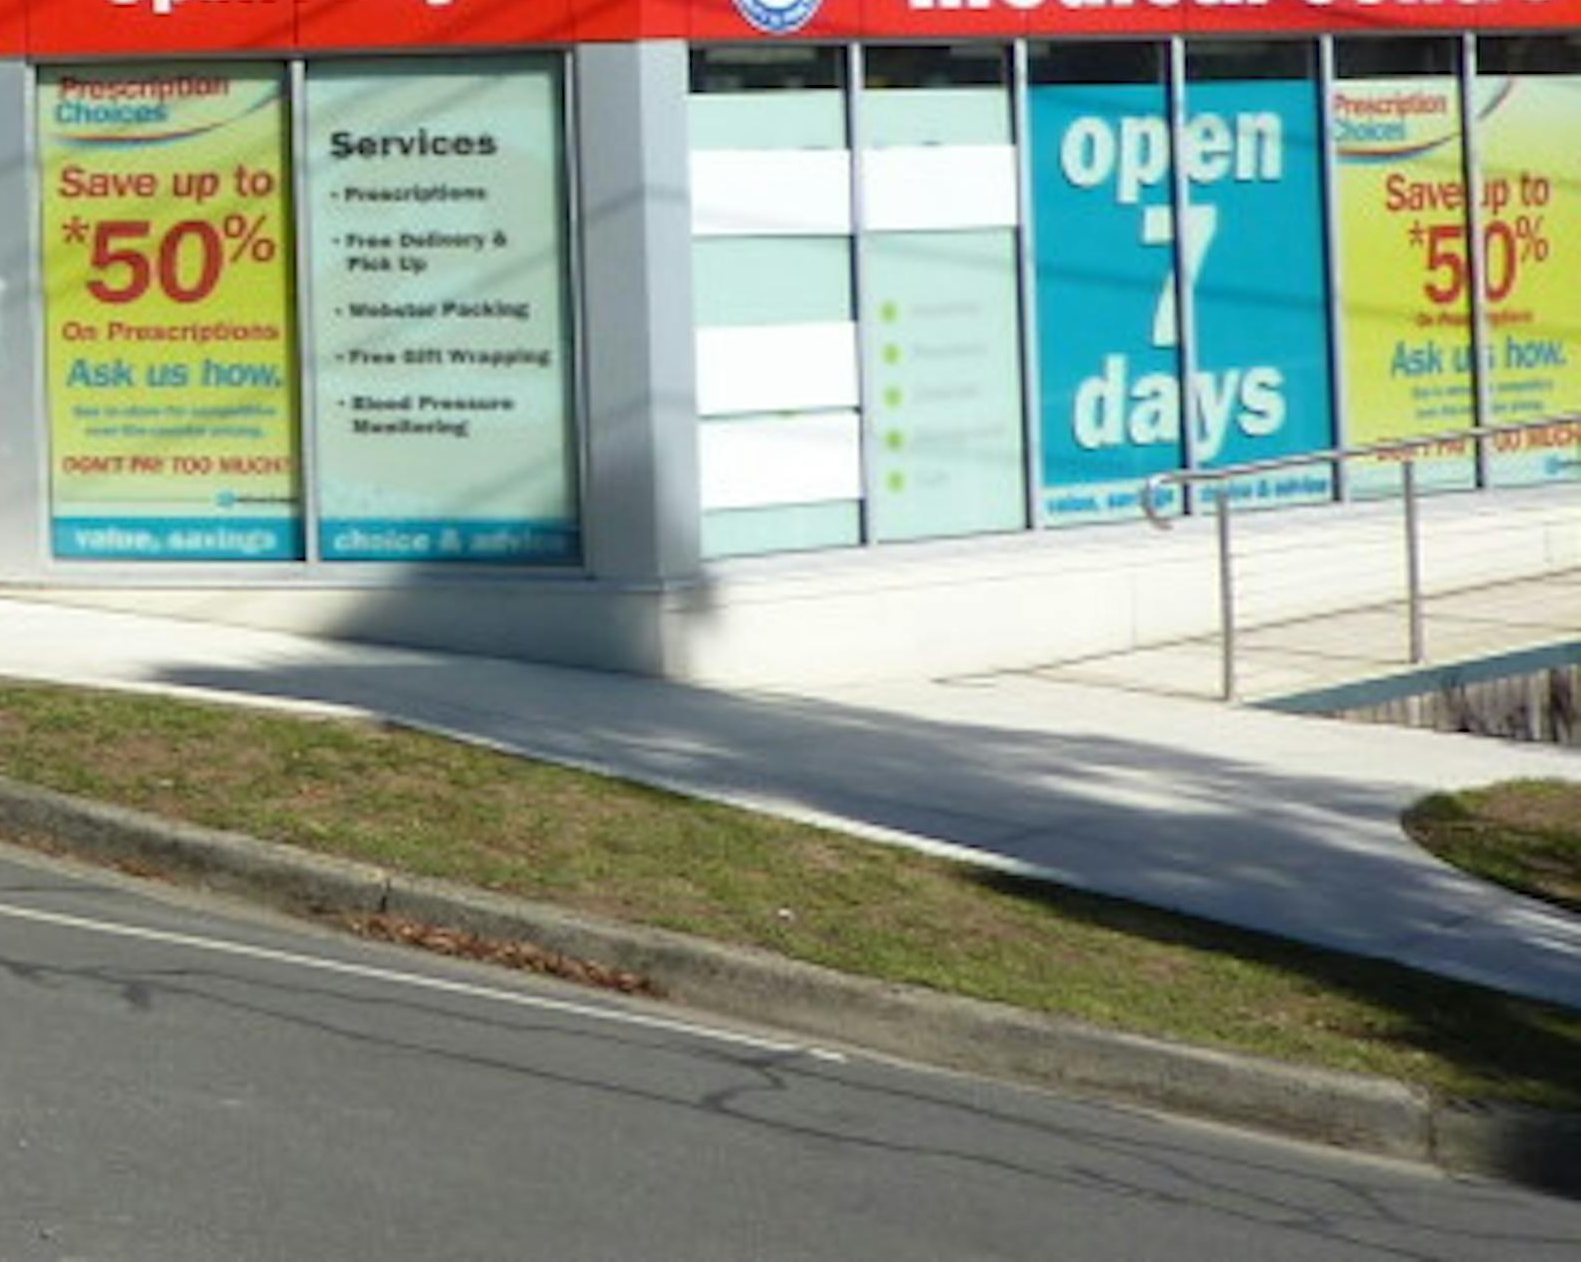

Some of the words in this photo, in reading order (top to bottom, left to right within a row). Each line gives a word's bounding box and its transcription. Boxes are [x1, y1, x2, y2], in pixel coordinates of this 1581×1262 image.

[59, 75, 230, 102] Prescription
[55, 100, 168, 124] Choices
[330, 127, 499, 160] Services
[1059, 111, 1283, 204] open
[57, 163, 159, 199] Save
[172, 167, 220, 205] up
[234, 161, 276, 198] to
[1385, 172, 1465, 213] Save
[1520, 170, 1550, 208] to
[1142, 203, 1218, 348] 7
[107, 320, 281, 344] Prescriptions
[65, 357, 136, 389] Ask
[144, 362, 188, 389] us
[201, 356, 282, 389] how.
[1391, 338, 1445, 379] Ask
[1073, 353, 1286, 463] days
[332, 527, 431, 552] choice
